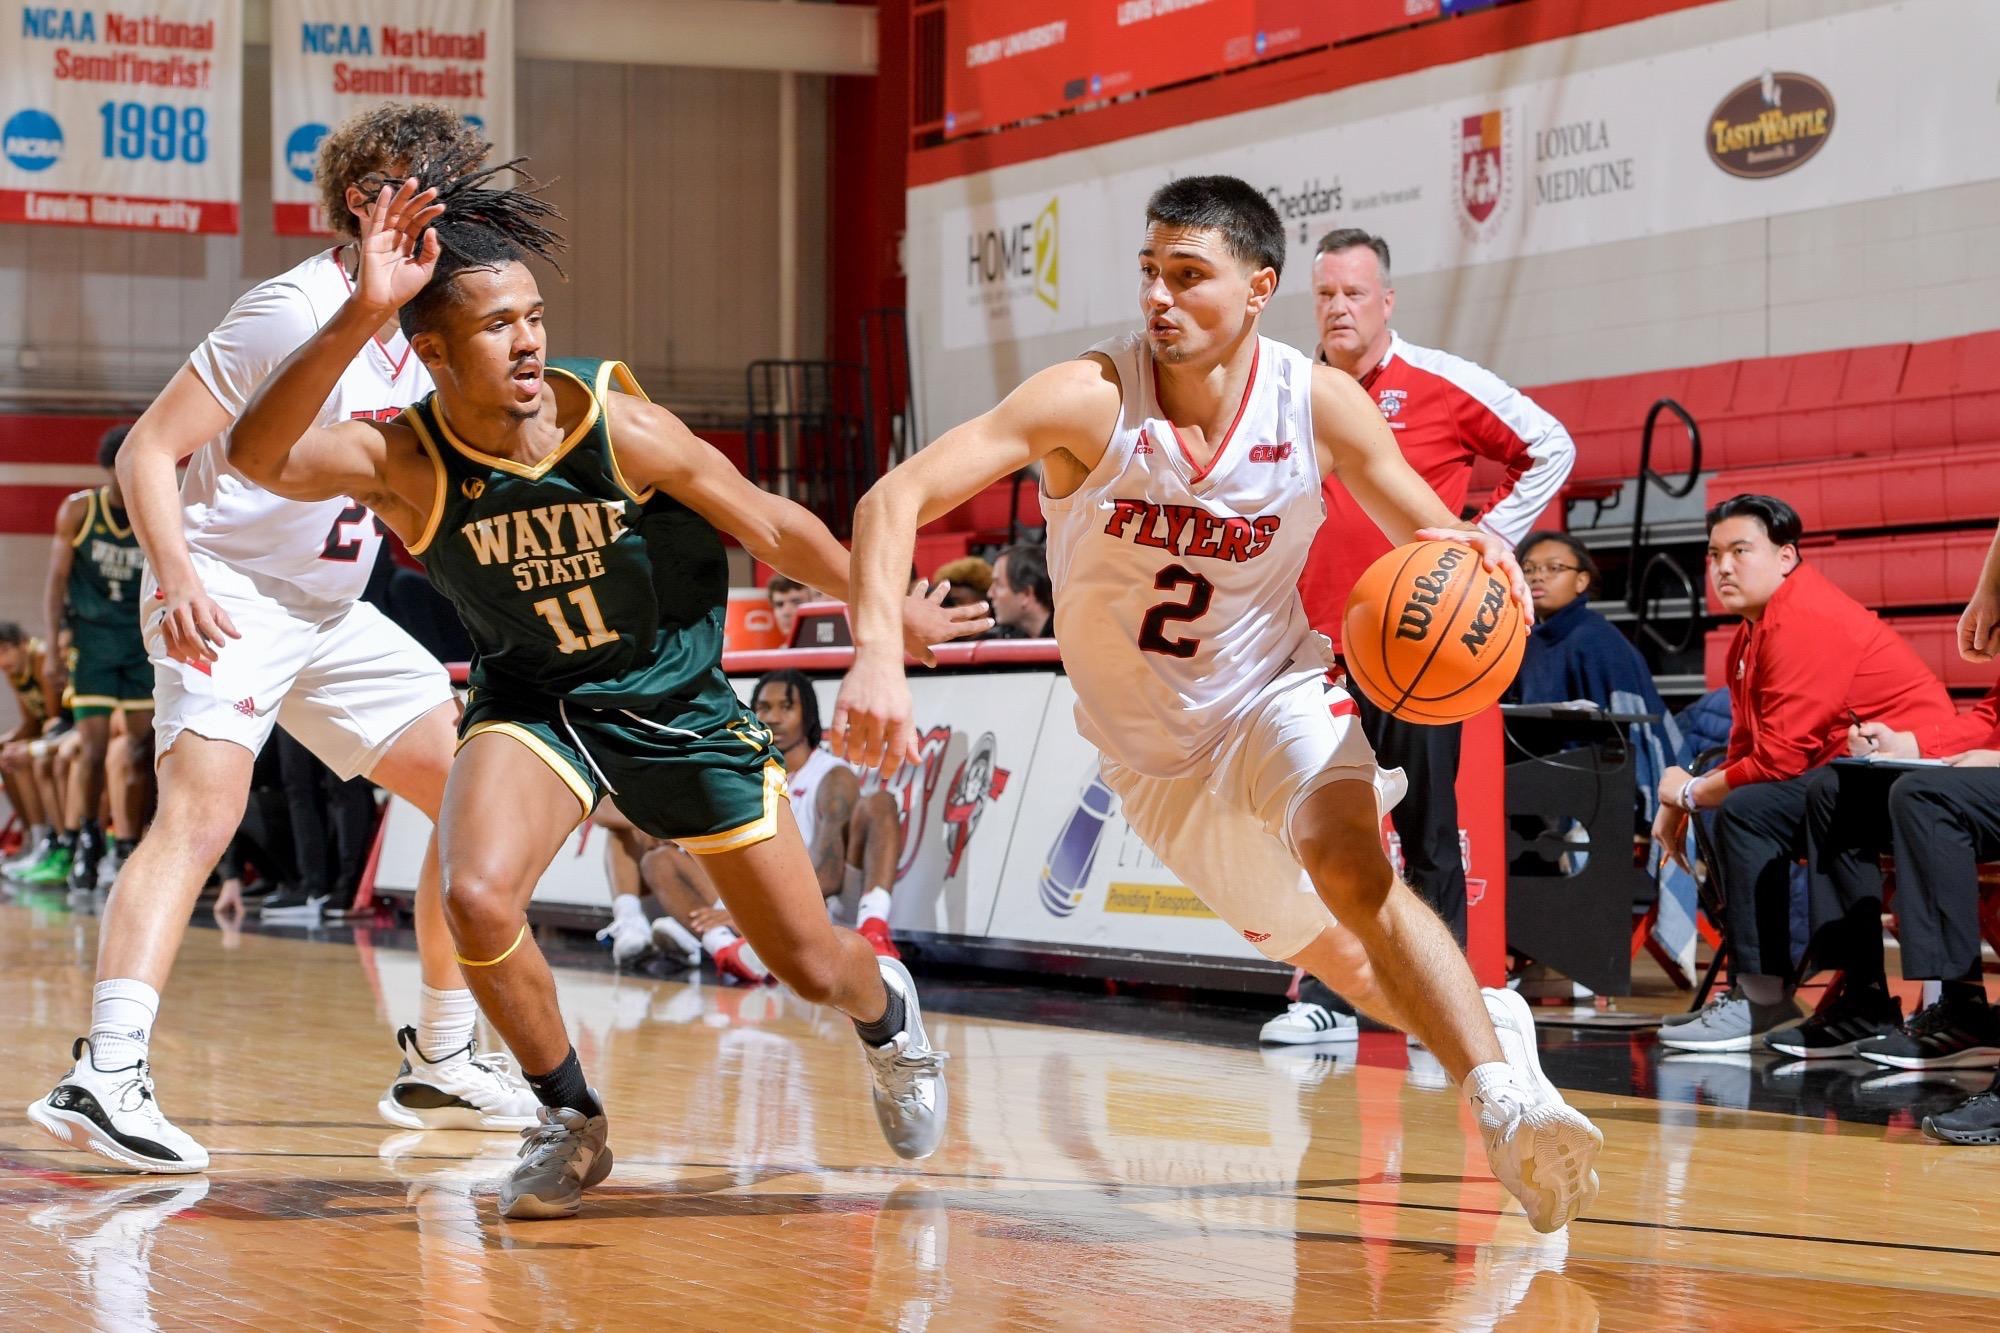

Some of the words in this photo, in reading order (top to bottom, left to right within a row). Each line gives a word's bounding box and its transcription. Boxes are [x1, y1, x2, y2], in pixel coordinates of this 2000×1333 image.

[22, 7, 96, 42] NCAA
[105, 12, 214, 50] National
[303, 23, 372, 55] NCAA
[380, 26, 486, 60] National
[54, 48, 212, 89] Semifinalist
[333, 61, 484, 98] Semifinalist
[99, 101, 207, 164] 1998
[1536, 119, 1610, 162] LOYOLA
[1535, 158, 1635, 207] MEDICINE
[25, 192, 88, 223] Lewis
[91, 195, 201, 233] University
[967, 223, 1033, 286] HOME
[1104, 499, 1281, 562] FLYERS
[512, 550, 606, 592] STATE
[1395, 547, 1468, 641] Wilson
[533, 585, 621, 655] 11
[1137, 564, 1215, 659] 2
[1461, 576, 1506, 658] NCAA
